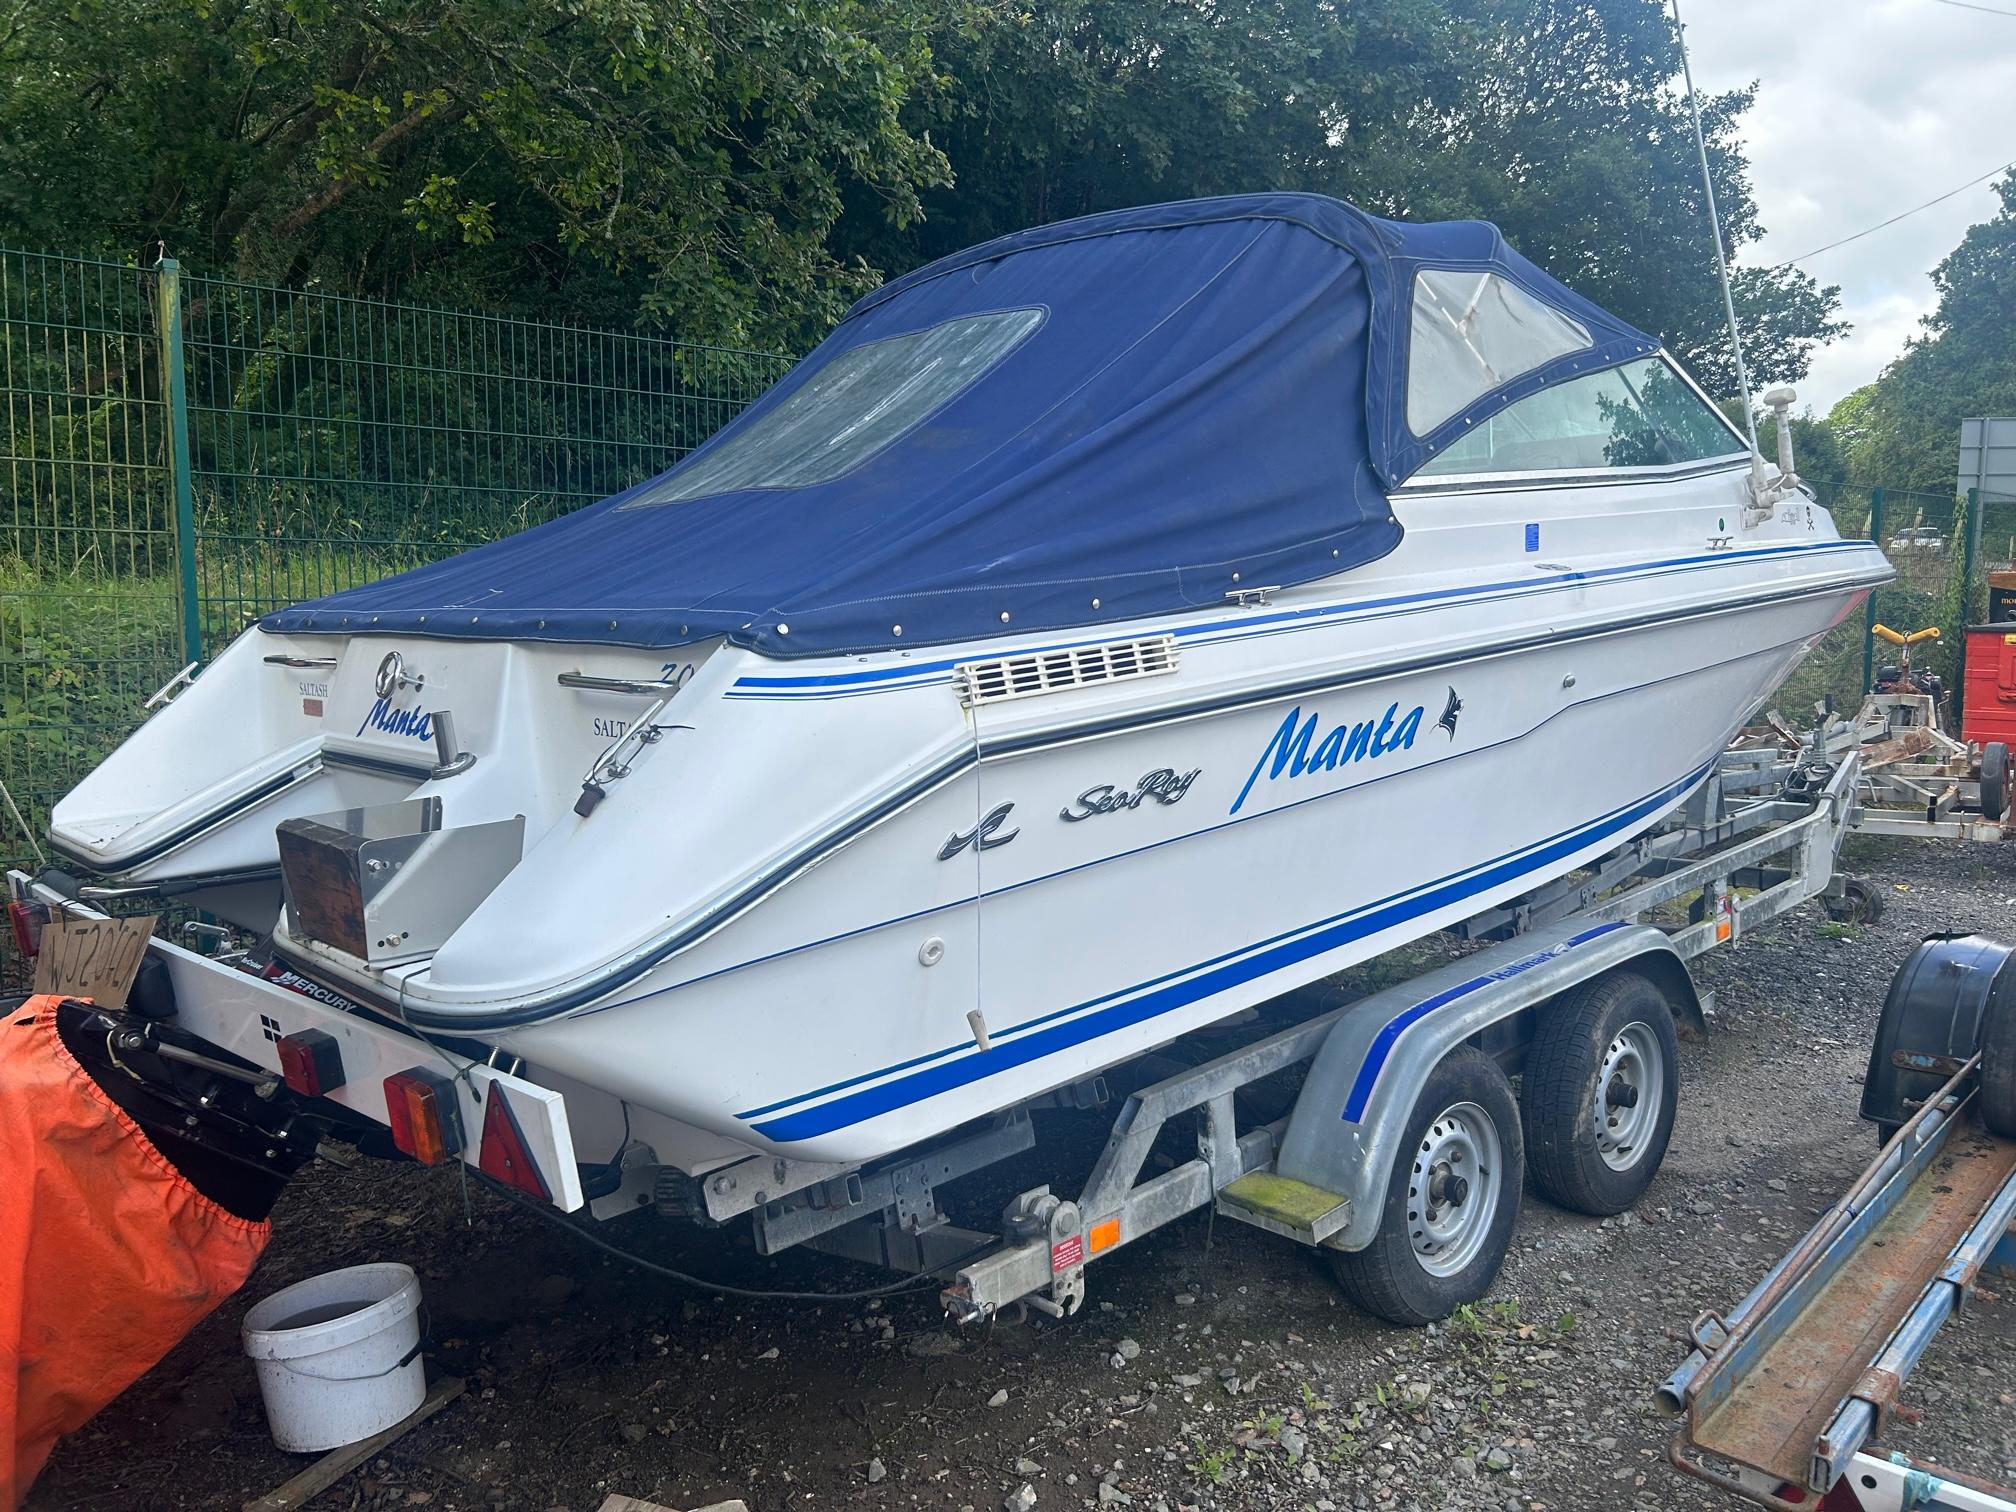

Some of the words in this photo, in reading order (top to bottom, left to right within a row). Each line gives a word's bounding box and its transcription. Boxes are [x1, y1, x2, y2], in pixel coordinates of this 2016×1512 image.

[299, 681, 329, 698] SALTASH
[356, 696, 435, 742] Manta
[1229, 701, 1425, 816] Manta
[1488, 951, 1557, 981] Hallmark
[270, 970, 357, 1012] MERCURY
